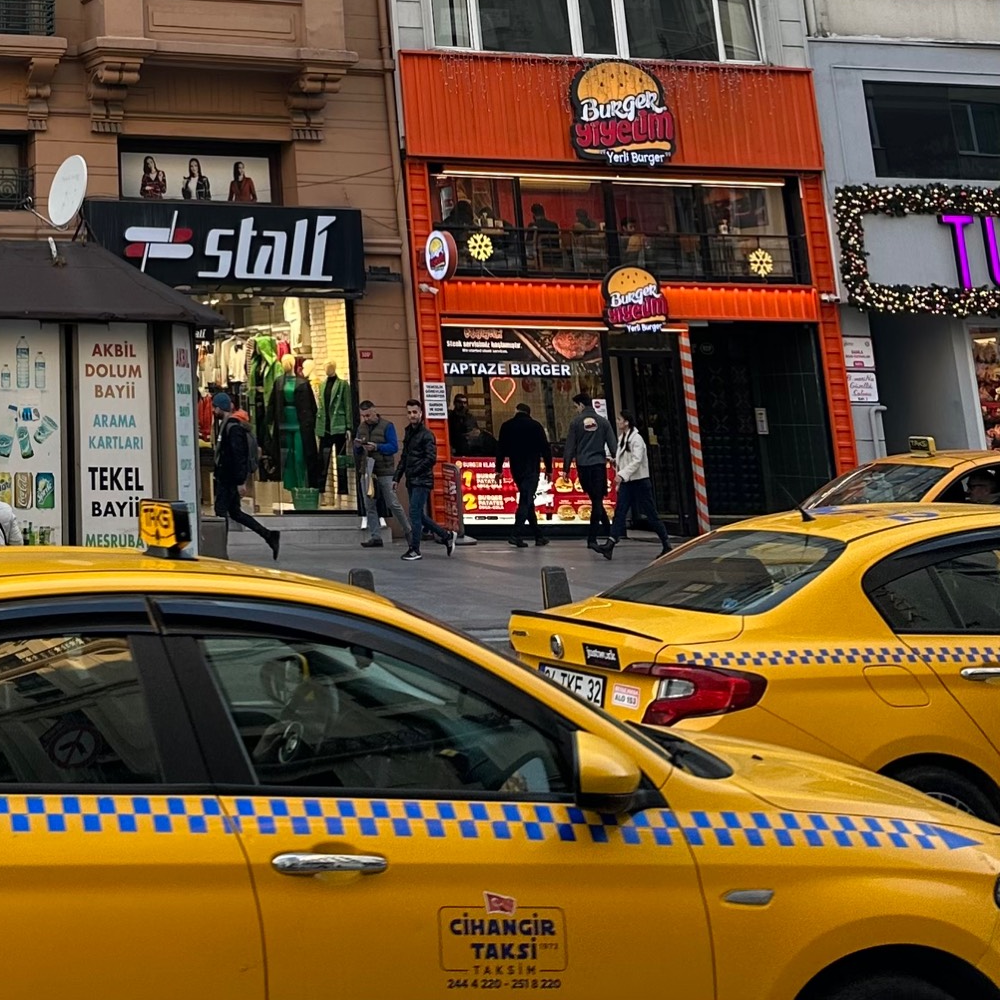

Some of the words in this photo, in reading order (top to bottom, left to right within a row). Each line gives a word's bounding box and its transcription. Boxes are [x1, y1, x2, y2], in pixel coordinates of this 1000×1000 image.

[92, 341, 136, 357] AKBİL
[85, 365, 142, 378] DOLUM
[443, 362, 506, 376] TAPTAZE
[511, 364, 571, 376] BURGER
[93, 414, 136, 428] ARAMA
[89, 436, 143, 450] KARTLARI
[88, 467, 144, 490] TEKEL
[587, 679, 601, 703] 32
[450, 912, 555, 935] CİHANGİR
[471, 937, 537, 960] TAKSİ
[473, 962, 537, 975] TAKSİM
[447, 979, 468, 989] 244
[471, 979, 478, 988] 4
[481, 979, 501, 989] 220
[540, 979, 561, 989] 220
